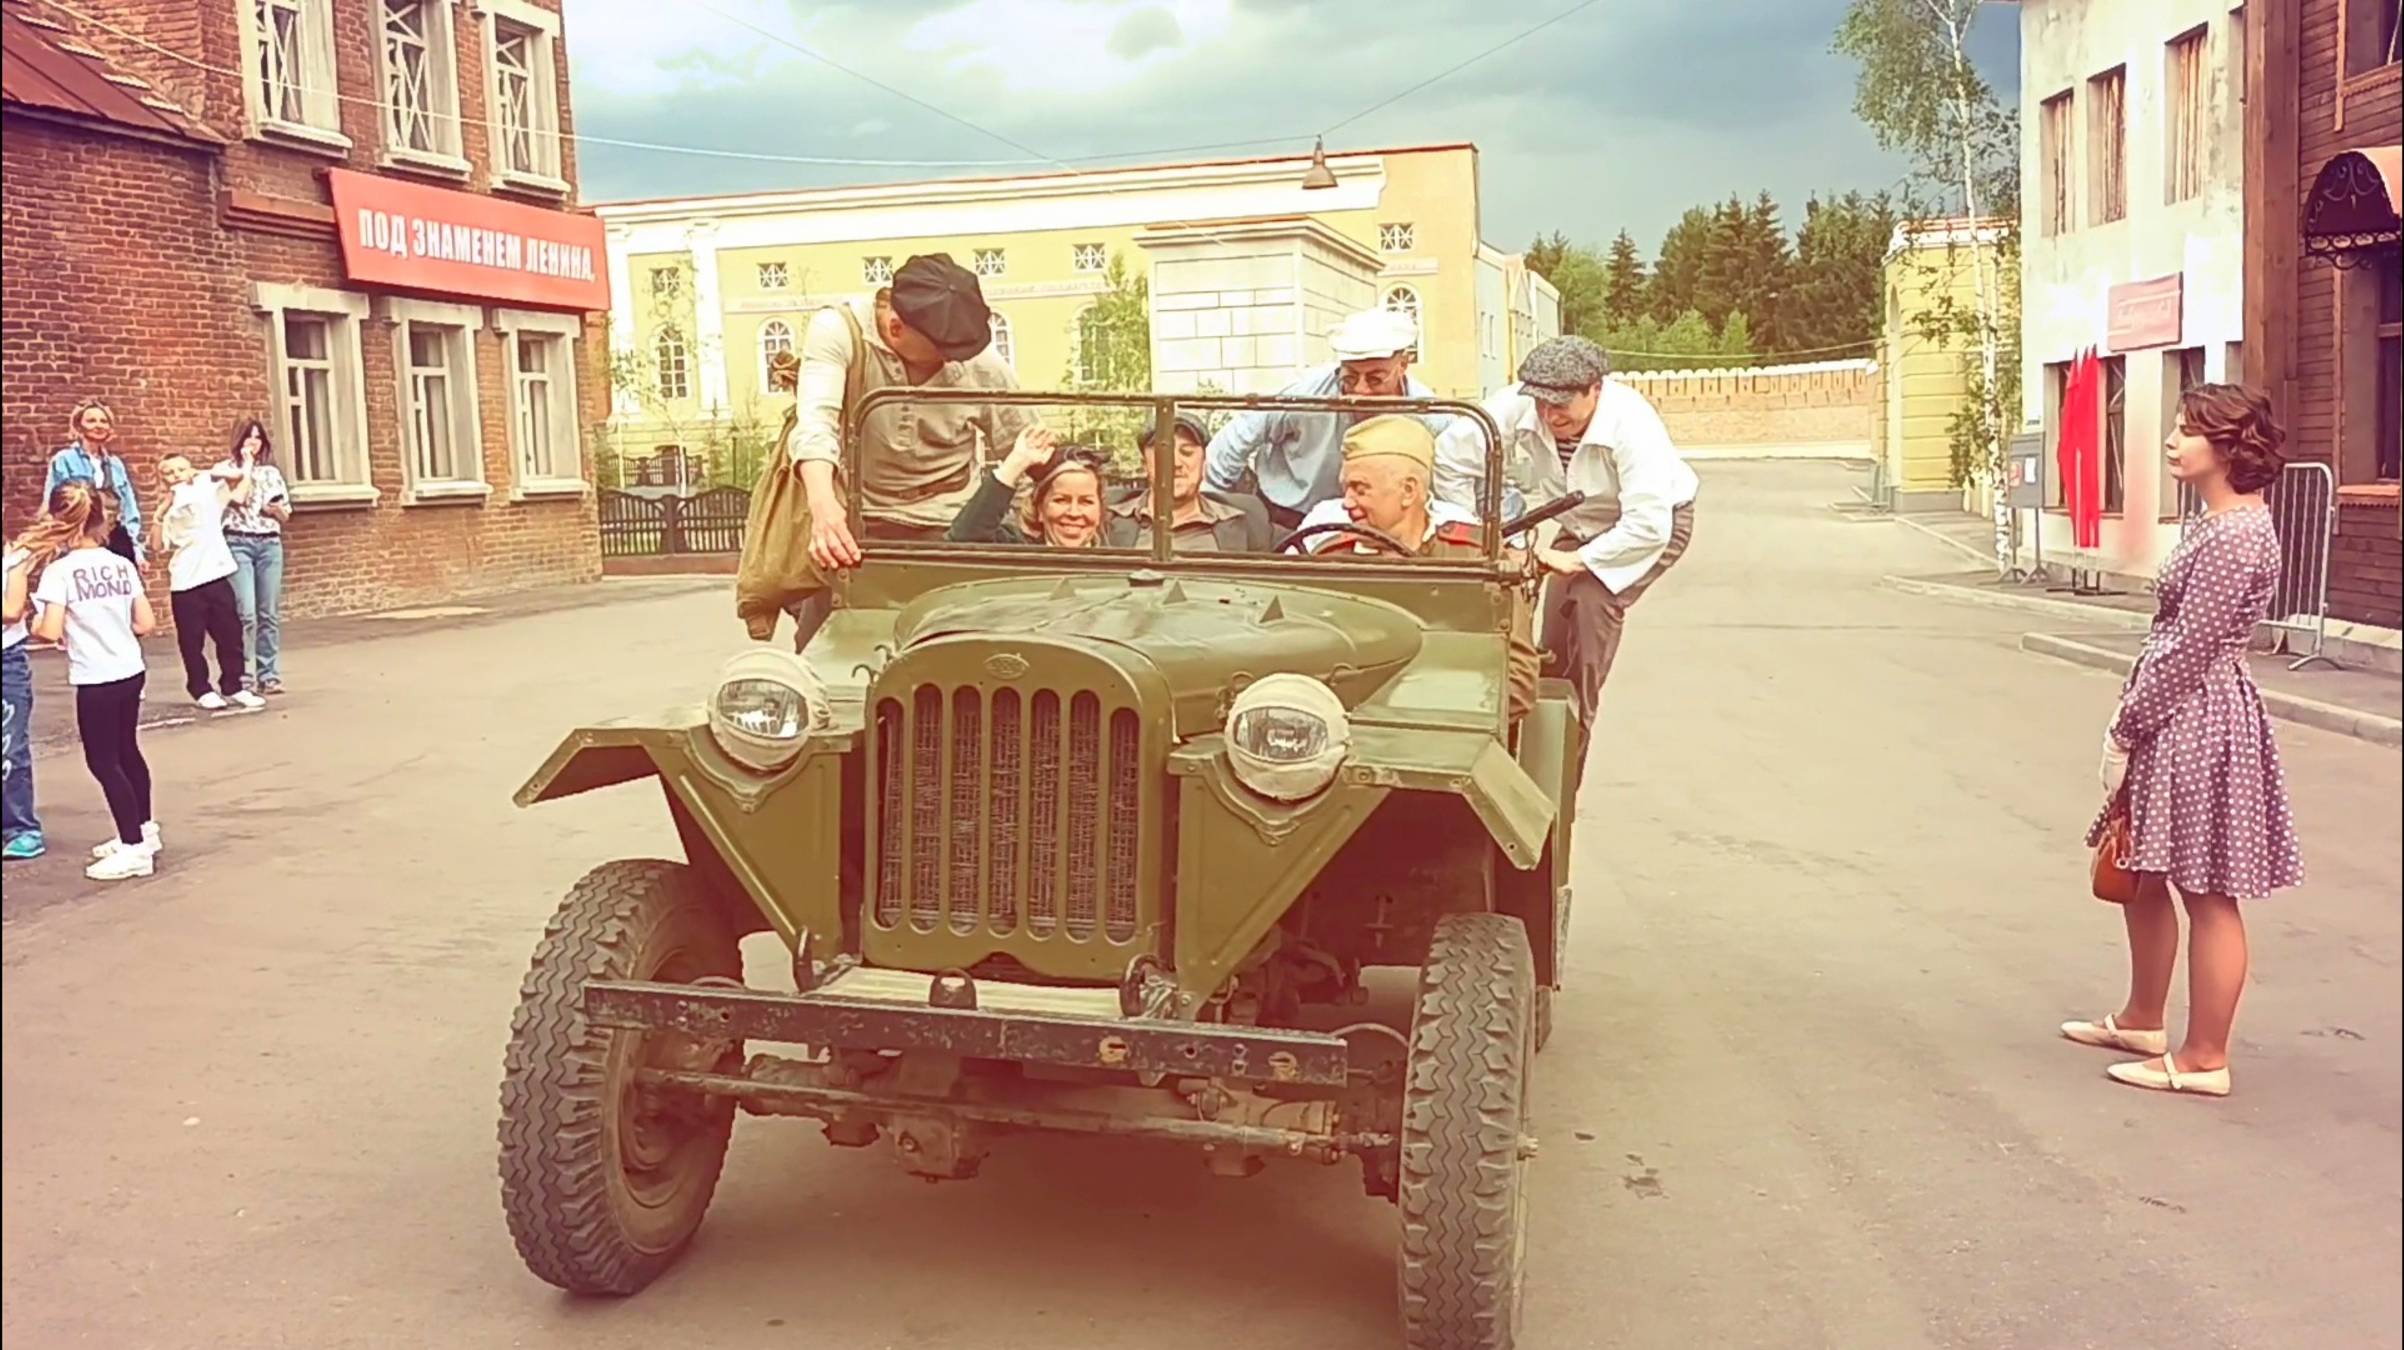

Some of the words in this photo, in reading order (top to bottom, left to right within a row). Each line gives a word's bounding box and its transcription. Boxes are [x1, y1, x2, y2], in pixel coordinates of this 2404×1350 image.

[358, 209, 406, 257] ПОД
[412, 219, 521, 269] ЗНАМЕНЕМ
[73, 565, 128, 583] RICH
[76, 580, 132, 601] MOND
